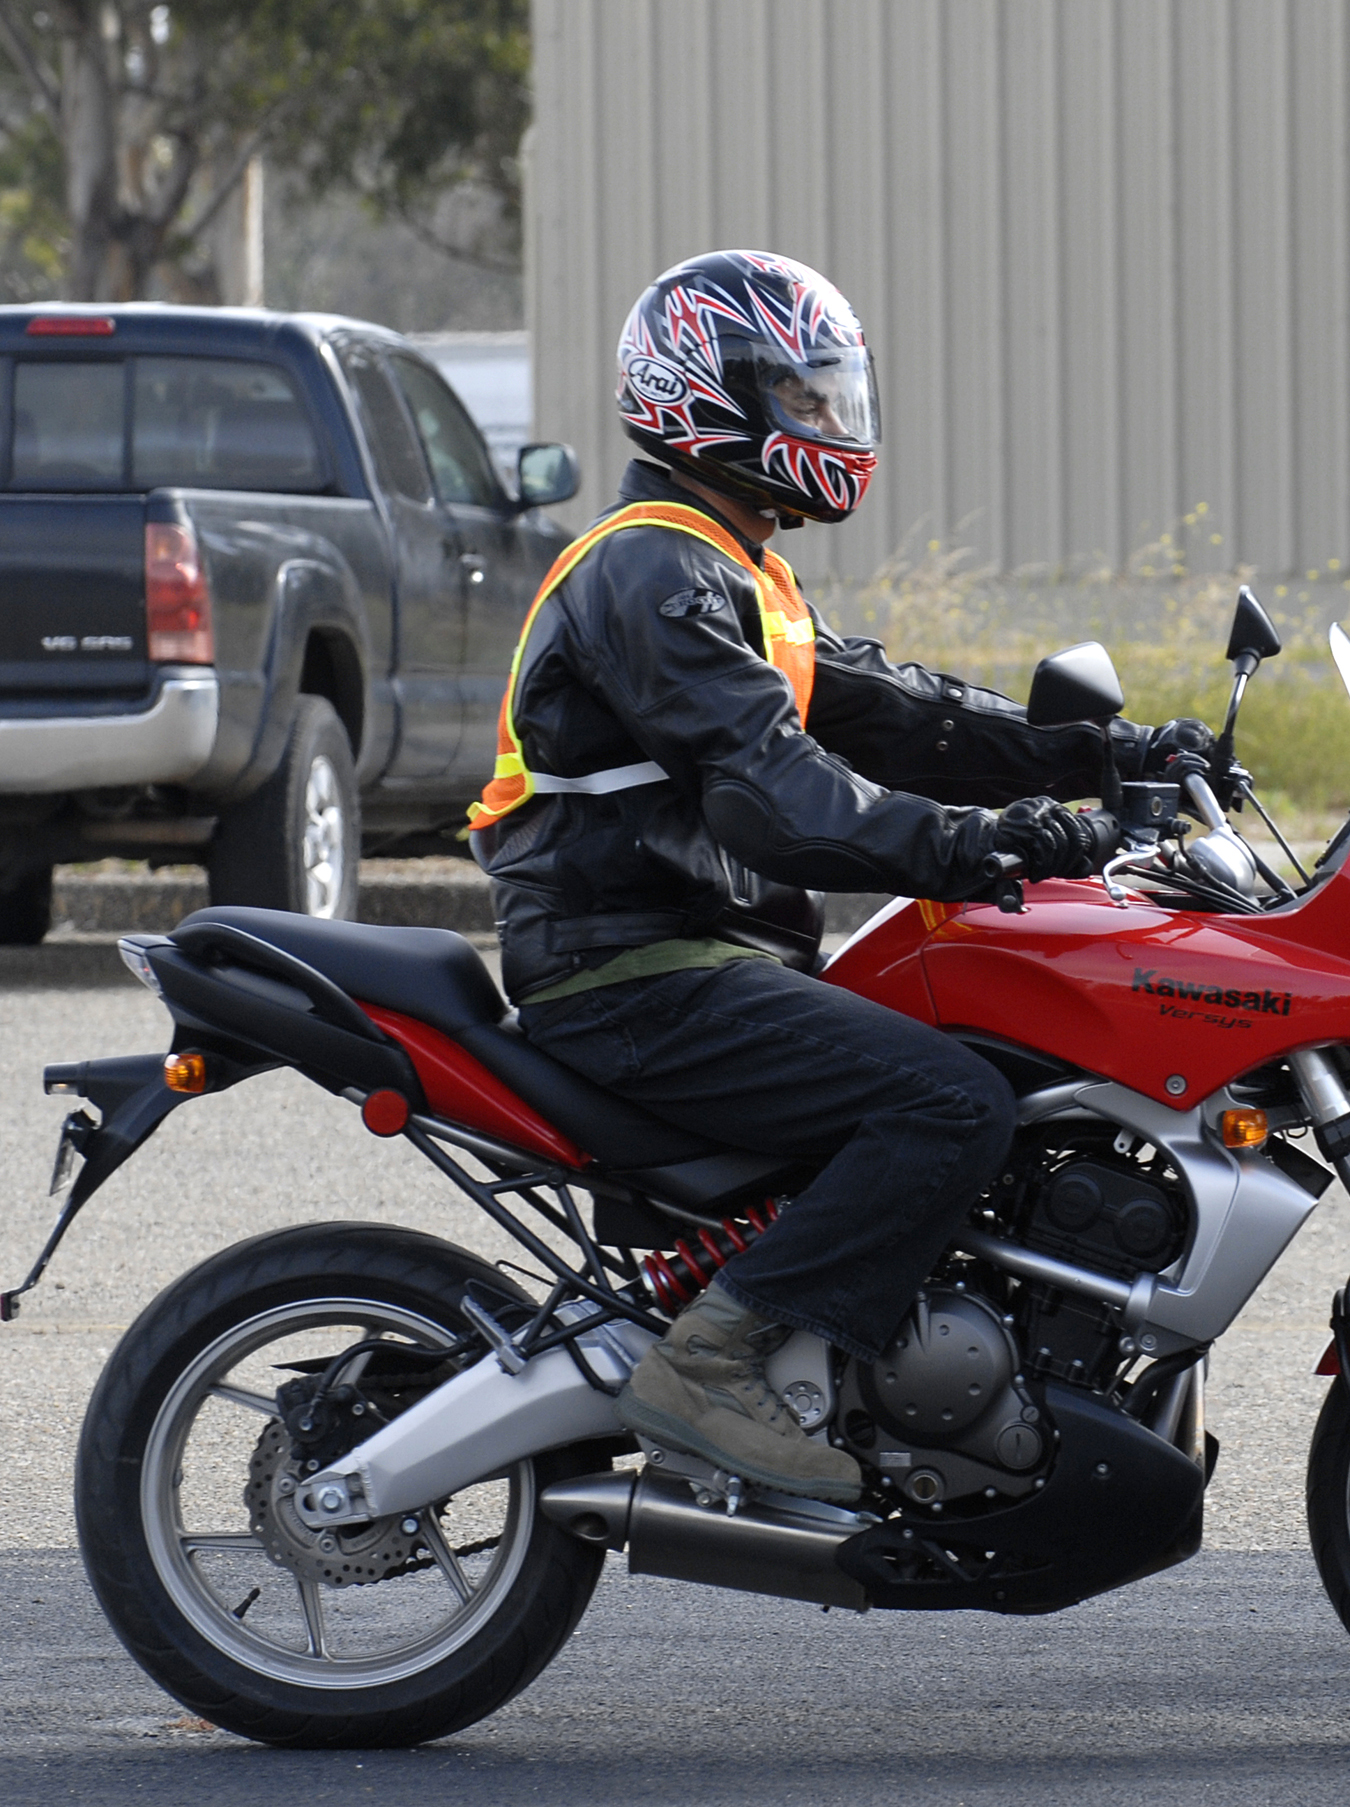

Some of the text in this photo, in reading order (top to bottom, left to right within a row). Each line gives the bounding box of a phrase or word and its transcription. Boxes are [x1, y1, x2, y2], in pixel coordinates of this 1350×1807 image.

[630, 363, 677, 395] Arai
[1132, 967, 1293, 1017] Kawasaki
[1158, 1003, 1253, 1030] Versys
